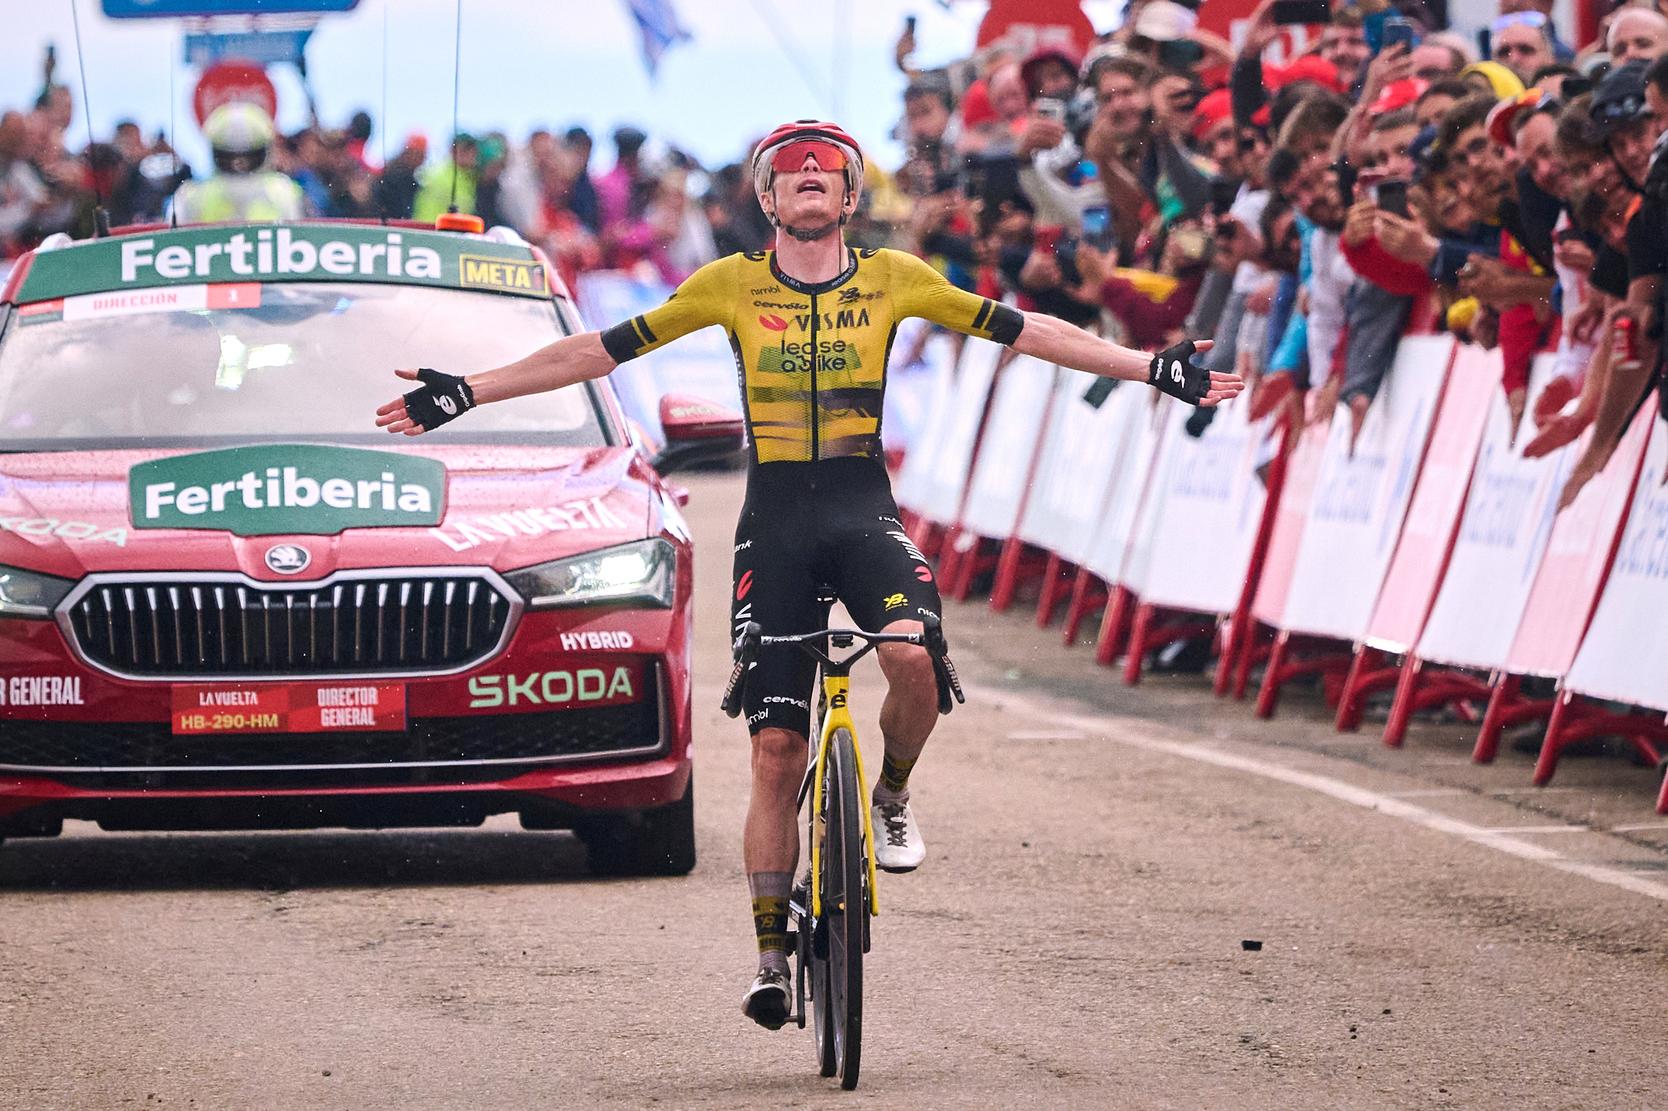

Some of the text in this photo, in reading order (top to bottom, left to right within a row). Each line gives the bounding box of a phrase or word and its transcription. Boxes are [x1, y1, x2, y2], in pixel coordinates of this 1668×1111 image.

[120, 230, 442, 281] Fertiberia
[465, 261, 531, 290] META
[93, 293, 178, 311] DIRECCIÓN
[780, 339, 847, 355] lease
[145, 466, 432, 519] Fertiberia
[560, 631, 634, 651] HYBRID
[9, 676, 84, 706] GENERAL
[200, 691, 259, 706] LA VUELTA
[317, 687, 378, 706] DIRECTOR
[181, 714, 279, 730] HB-290-HM
[321, 707, 376, 727] GENERAL
